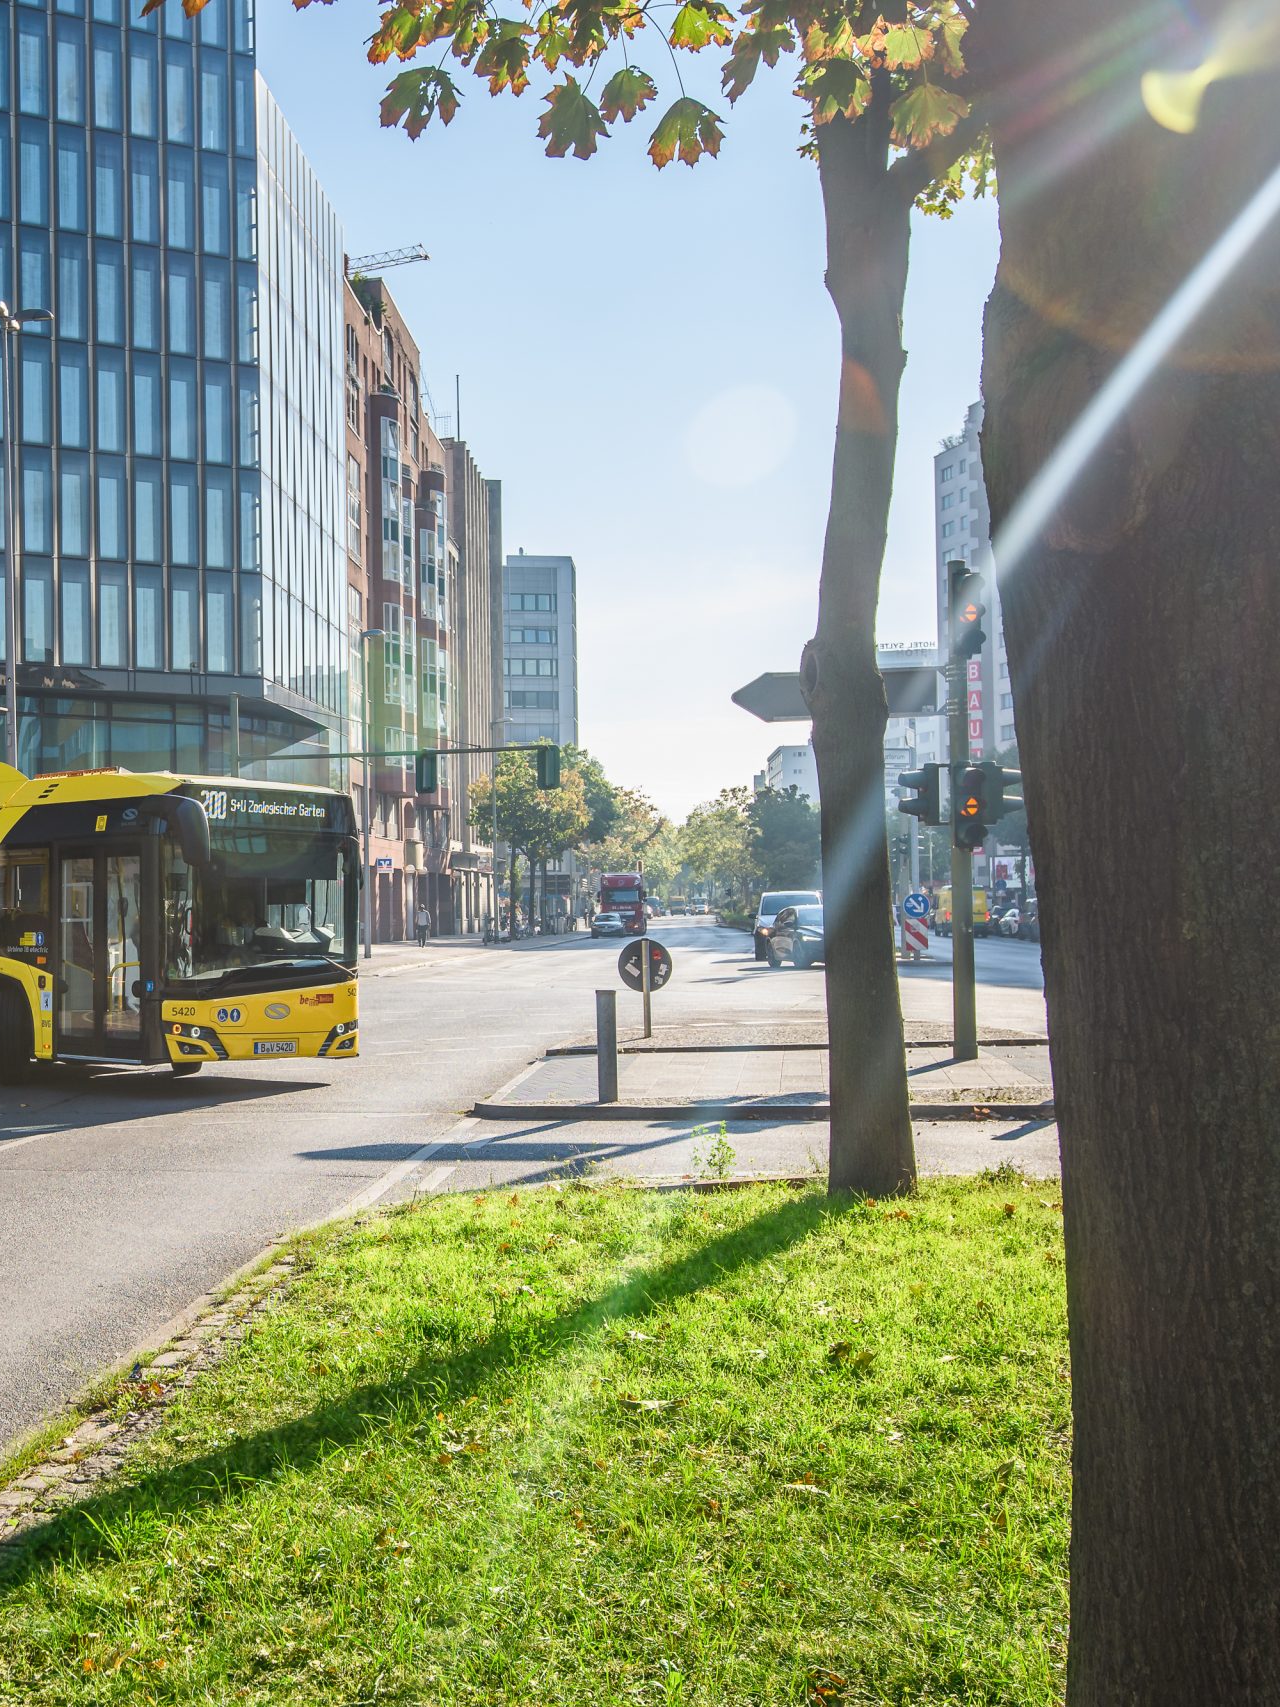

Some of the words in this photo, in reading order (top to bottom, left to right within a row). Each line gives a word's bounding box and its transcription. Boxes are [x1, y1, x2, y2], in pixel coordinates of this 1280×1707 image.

[200, 789, 227, 820] 200
[230, 799, 247, 812] S+U
[248, 800, 298, 816] Zoologischer
[299, 803, 325, 818] Garten
[171, 1007, 196, 1017] 5420
